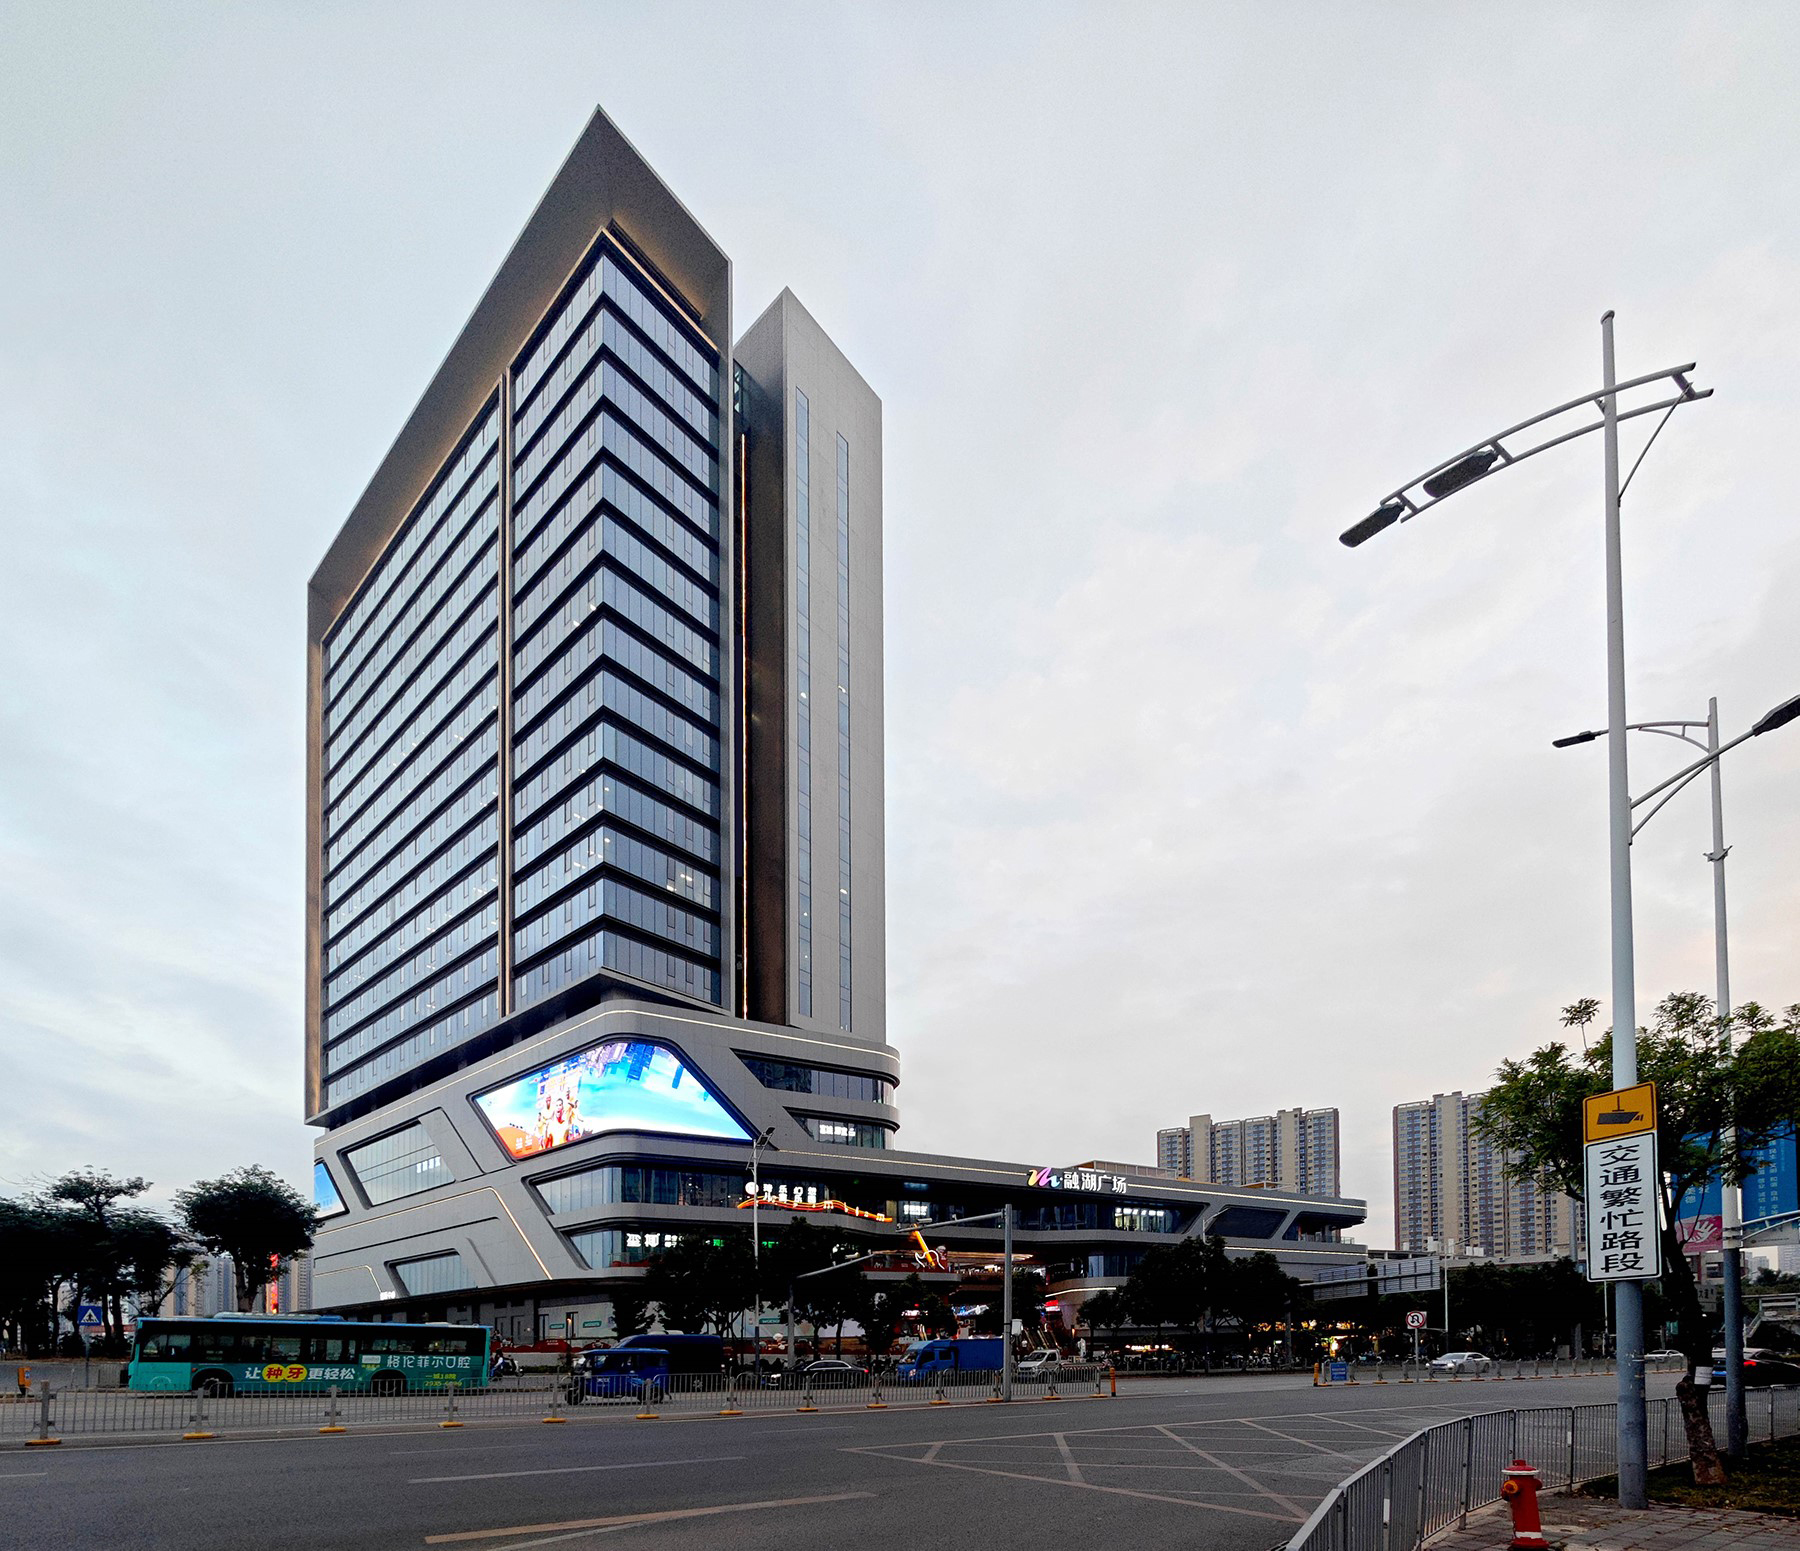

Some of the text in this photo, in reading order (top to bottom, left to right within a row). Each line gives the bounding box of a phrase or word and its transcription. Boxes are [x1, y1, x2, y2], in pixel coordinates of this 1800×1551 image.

[1063, 1171, 1127, 1194] 融湖广场
[1599, 1144, 1645, 1273] 交通繁忙路段
[386, 1354, 472, 1369] 格伦菲尔口腔
[244, 1366, 356, 1380] 让种牙更轻松
